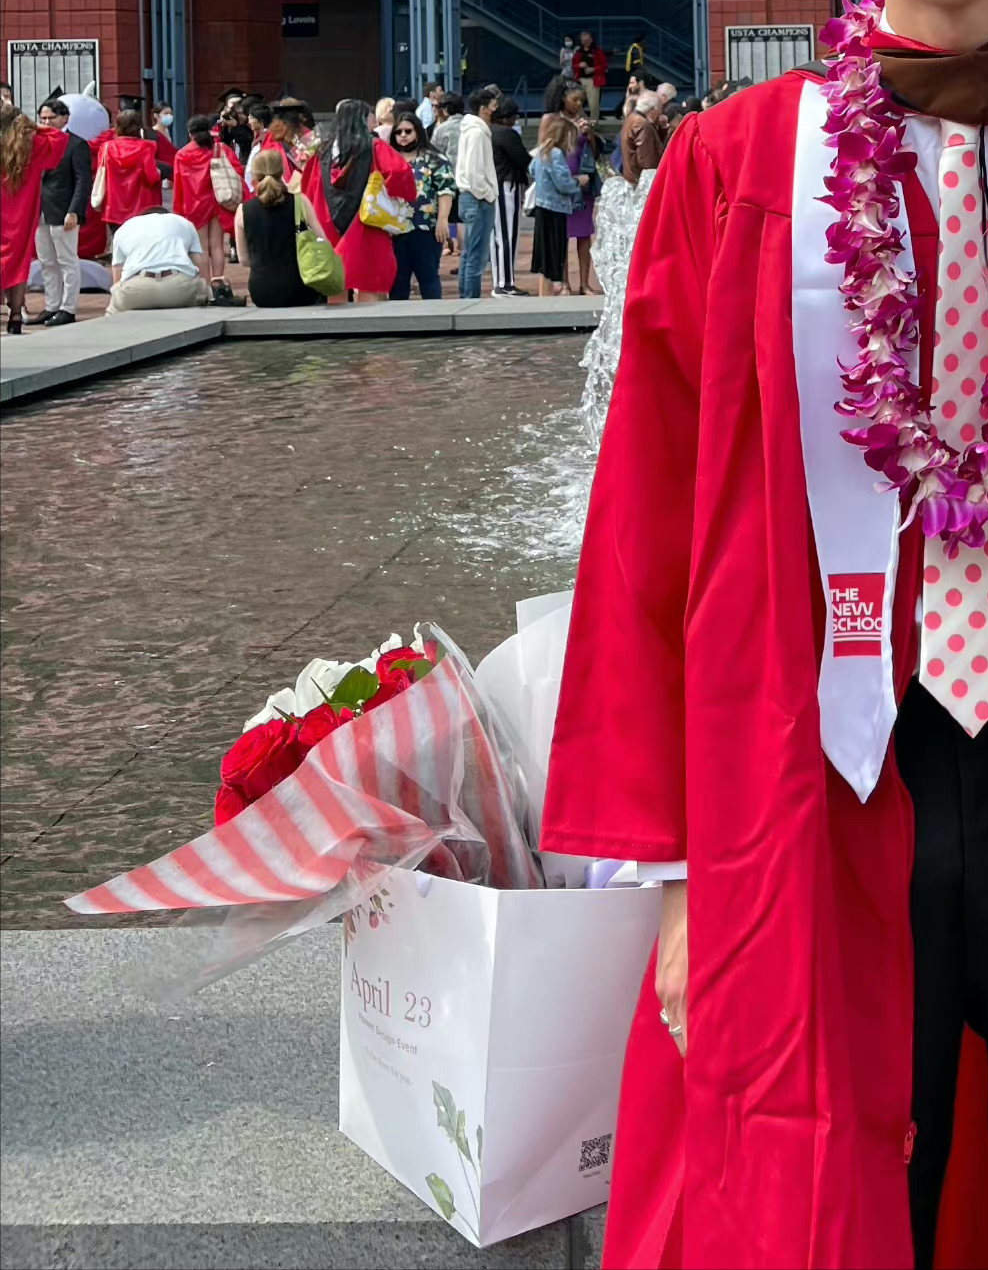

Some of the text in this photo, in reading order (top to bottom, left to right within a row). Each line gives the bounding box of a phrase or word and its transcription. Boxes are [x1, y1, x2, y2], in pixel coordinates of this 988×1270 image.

[42, 42, 93, 50] CHAMPIONS
[830, 588, 859, 601] THE
[831, 602, 874, 617] NEW
[351, 960, 432, 1028] April 23
[397, 1038, 418, 1056] Event
